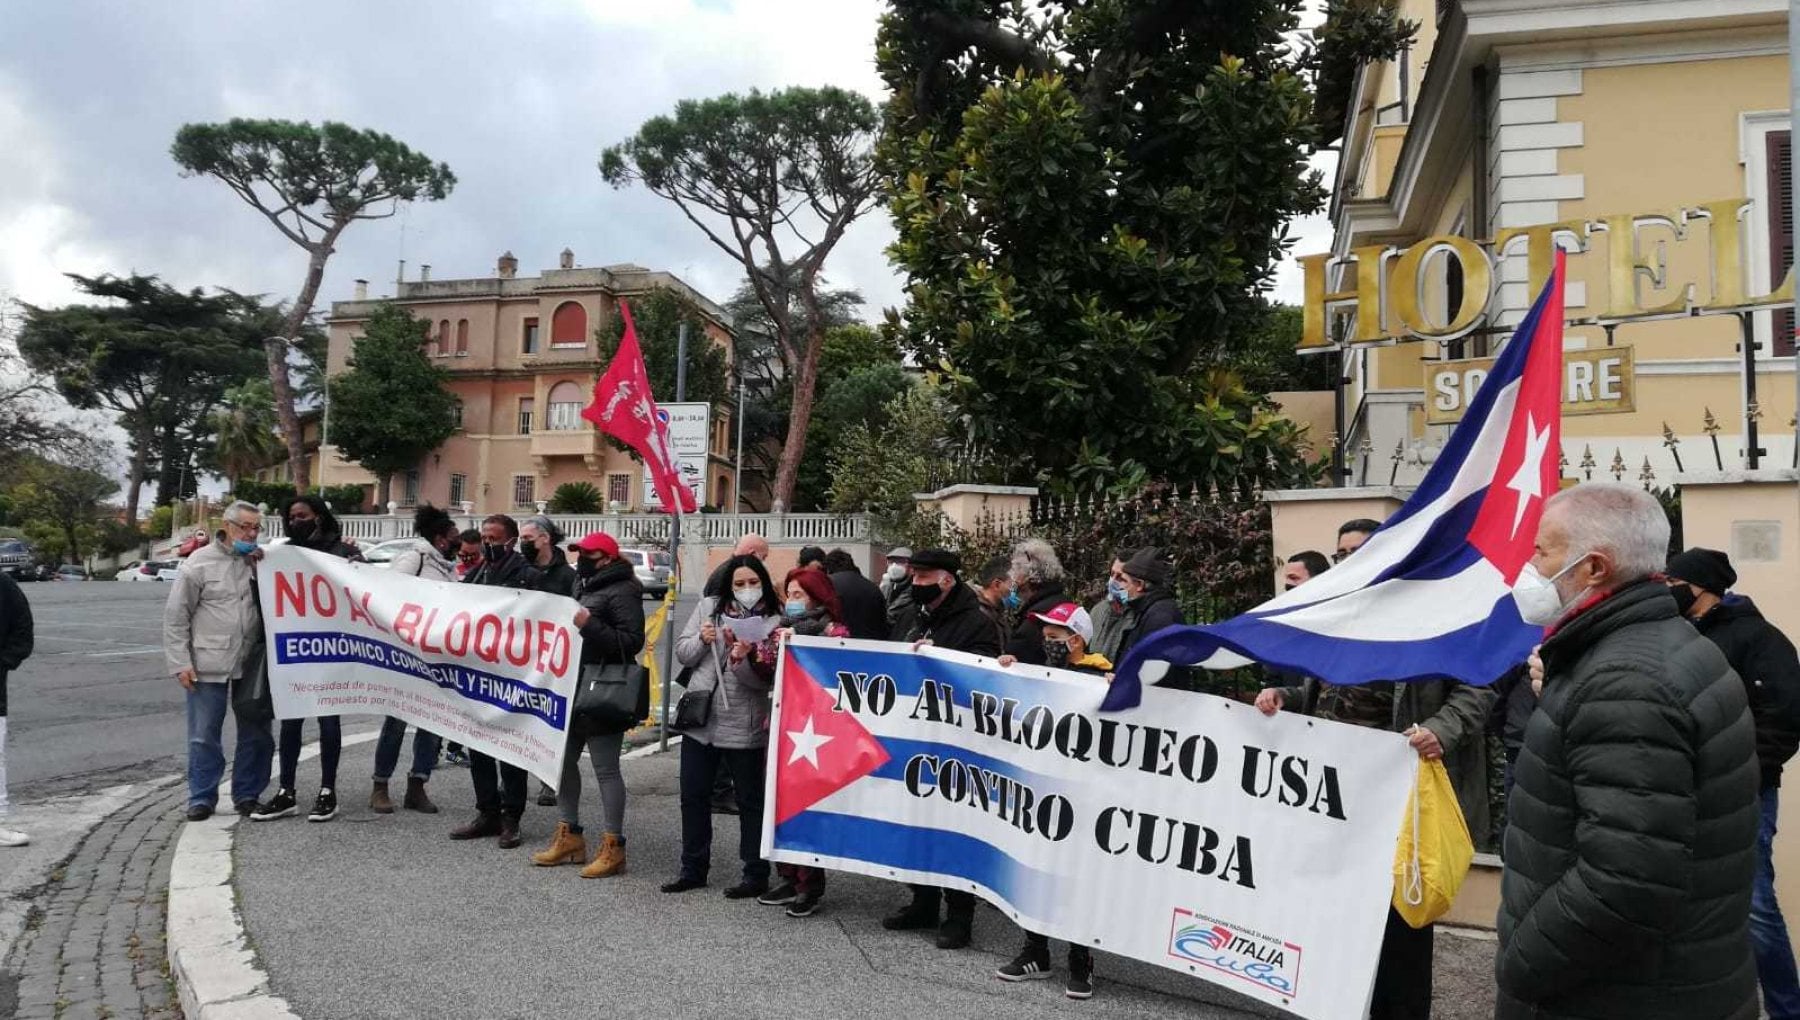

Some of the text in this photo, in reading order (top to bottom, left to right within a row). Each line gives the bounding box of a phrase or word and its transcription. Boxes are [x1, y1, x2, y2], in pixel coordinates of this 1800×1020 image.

[1297, 198, 1797, 350] HOTEL
[1435, 358, 1622, 412] SRE
[274, 571, 337, 618] NO
[393, 602, 571, 678] BLOQUEO
[286, 634, 390, 666] ECONÓMICO,
[466, 672, 476, 692] Y
[832, 670, 1347, 822] NO AL BLOQUEO USA
[903, 753, 1256, 889] CONTRO CUBA
[1228, 936, 1284, 968] ITALIA
